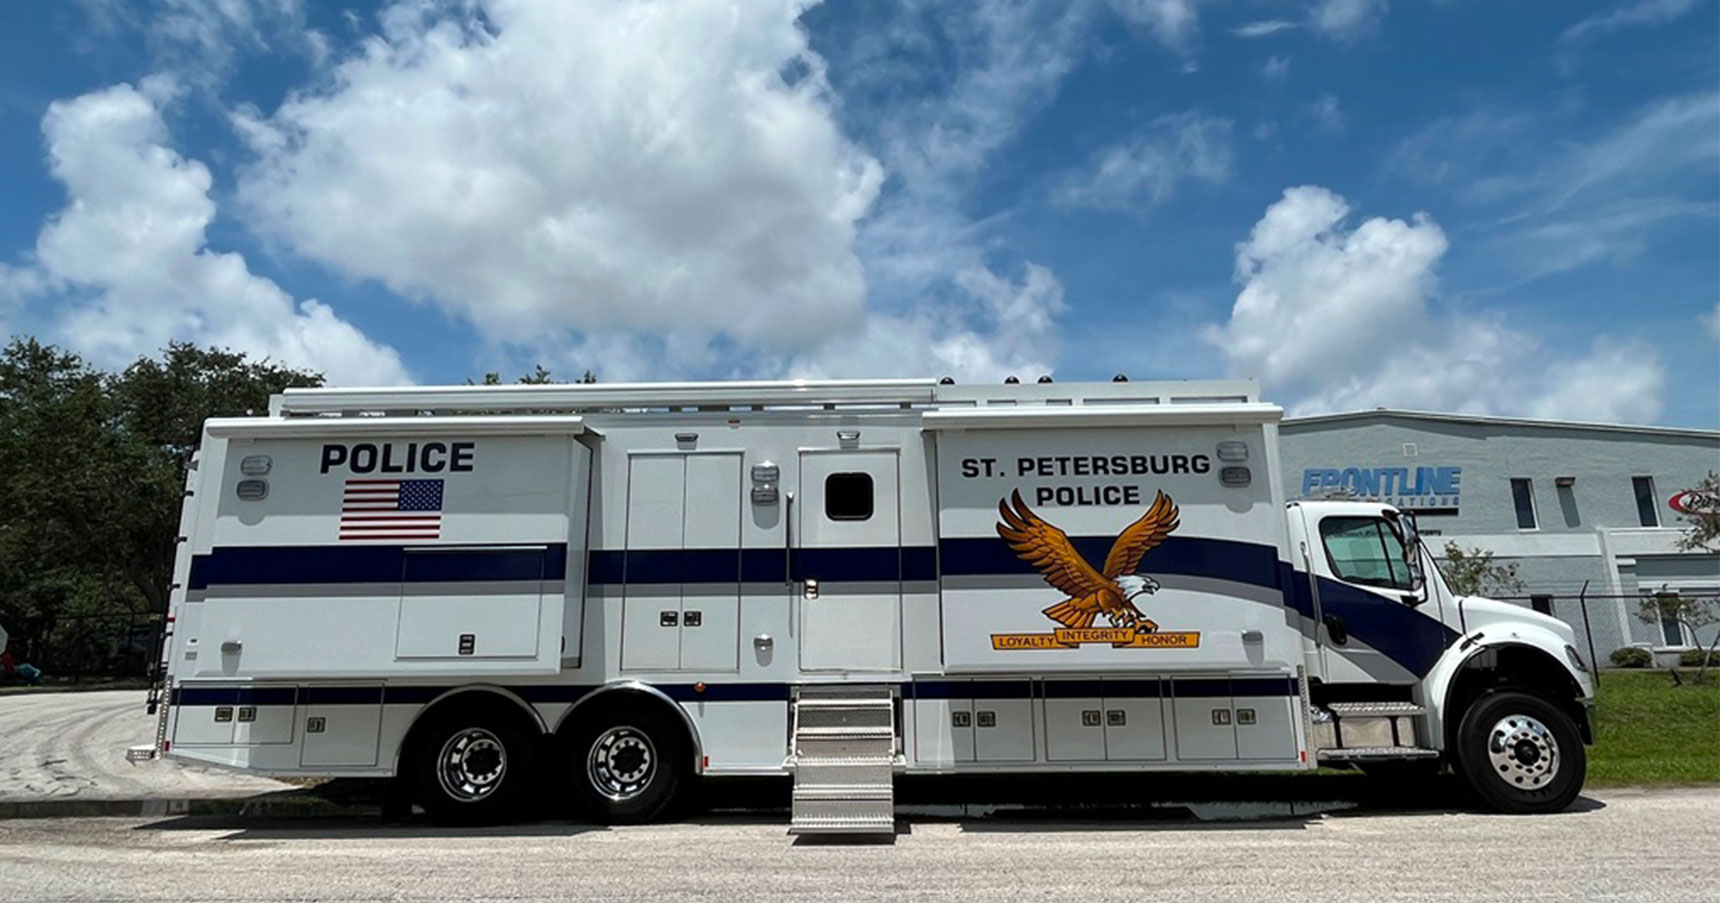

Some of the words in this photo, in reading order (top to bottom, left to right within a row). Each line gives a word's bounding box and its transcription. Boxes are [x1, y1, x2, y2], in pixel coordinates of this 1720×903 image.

[320, 442, 475, 474] POLICE
[961, 458, 1005, 478] ST.
[1017, 455, 1210, 477] PETERSBURG
[1302, 467, 1462, 497] FRONTLINE
[1036, 485, 1140, 507] POLICE
[1385, 496, 1460, 507] CATIONS
[999, 636, 1055, 647] LOYALTY
[1062, 630, 1129, 641] INTEGRITY
[1141, 635, 1187, 646] HONOR
